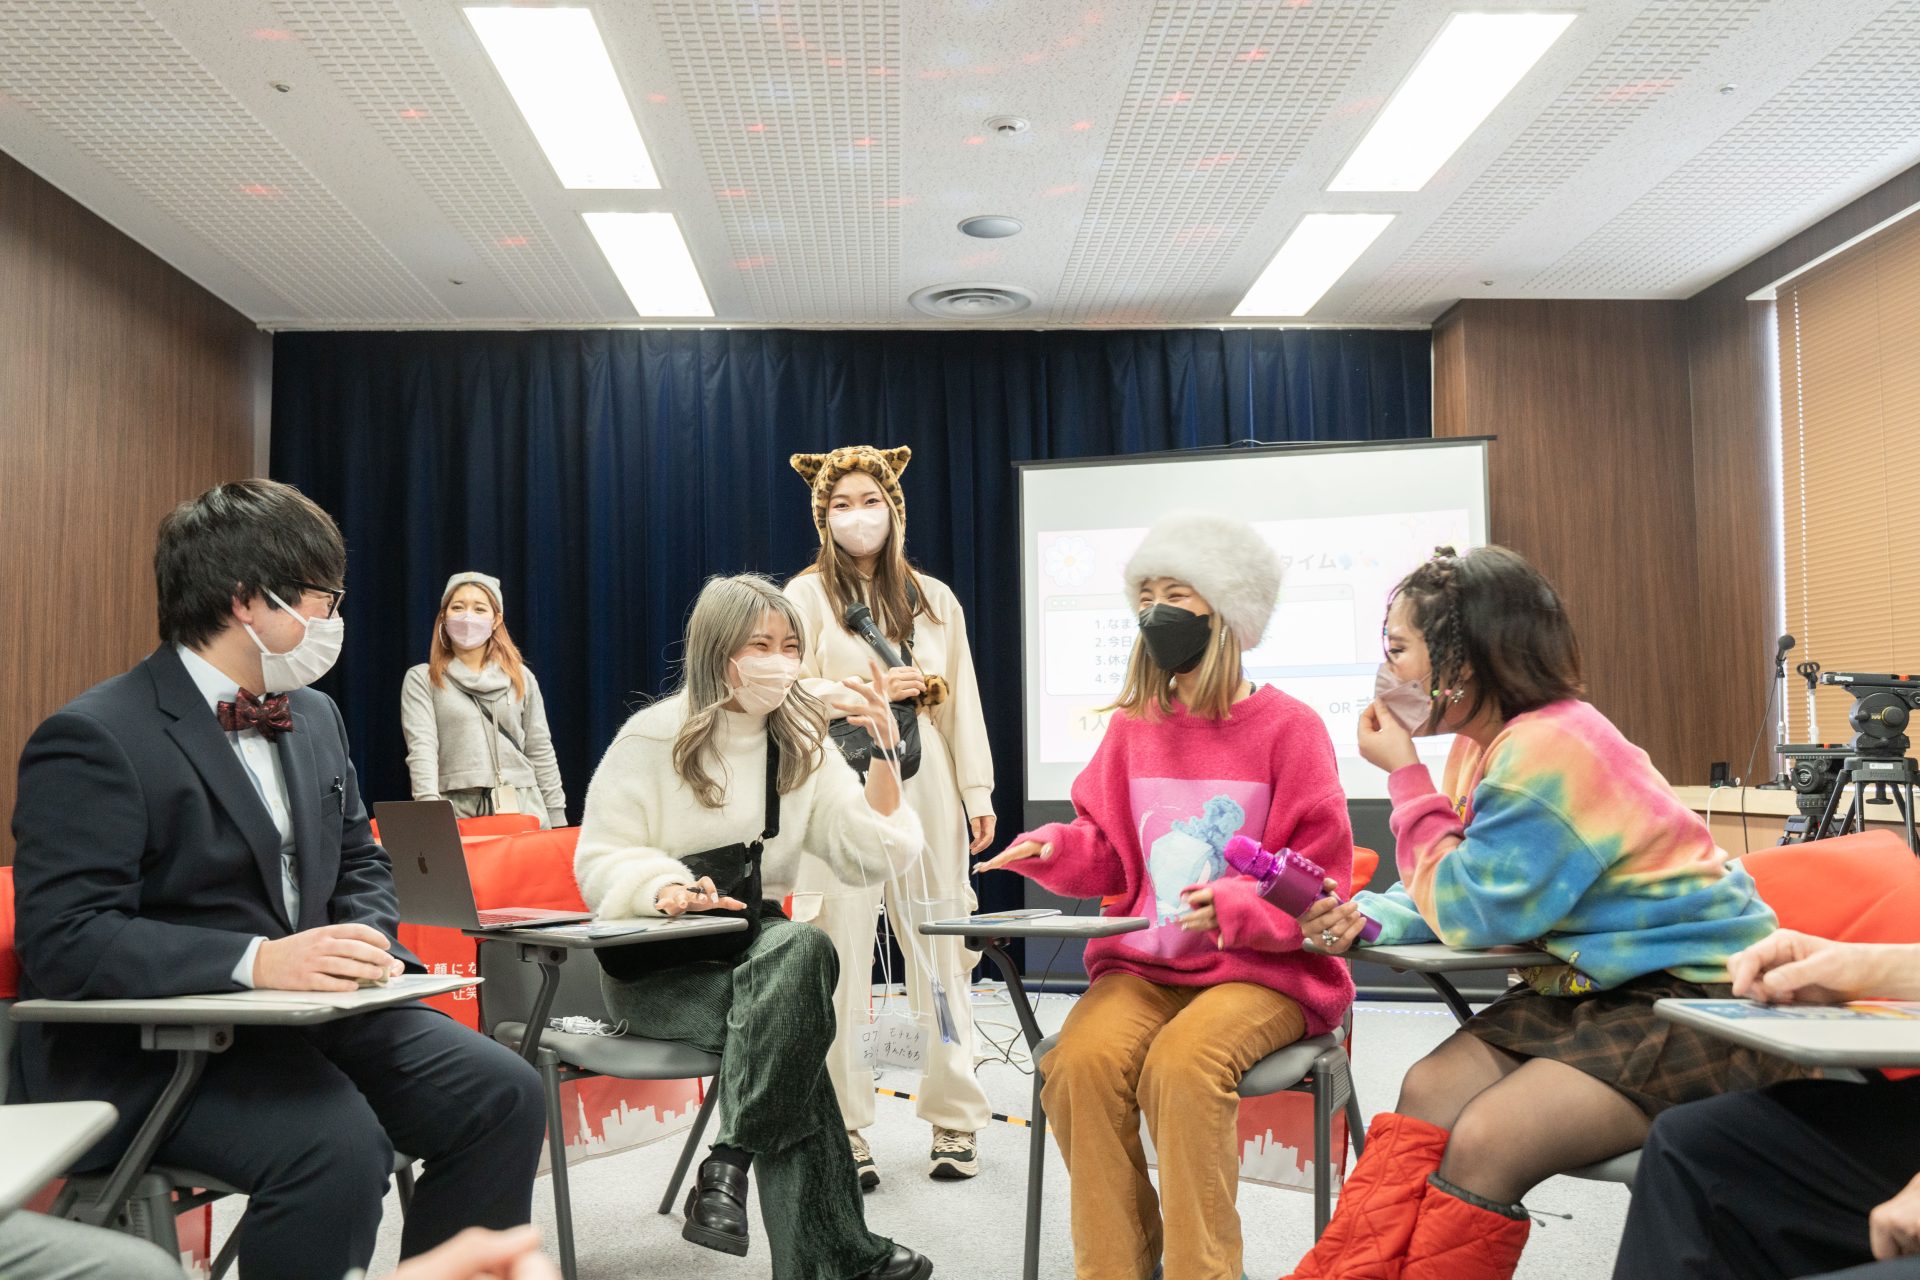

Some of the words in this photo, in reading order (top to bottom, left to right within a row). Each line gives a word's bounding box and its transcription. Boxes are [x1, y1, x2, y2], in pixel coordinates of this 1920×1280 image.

[1095, 618, 1132, 630] 1.なま
[1095, 672, 1126, 684] 4.今
[1329, 702, 1351, 714] OR
